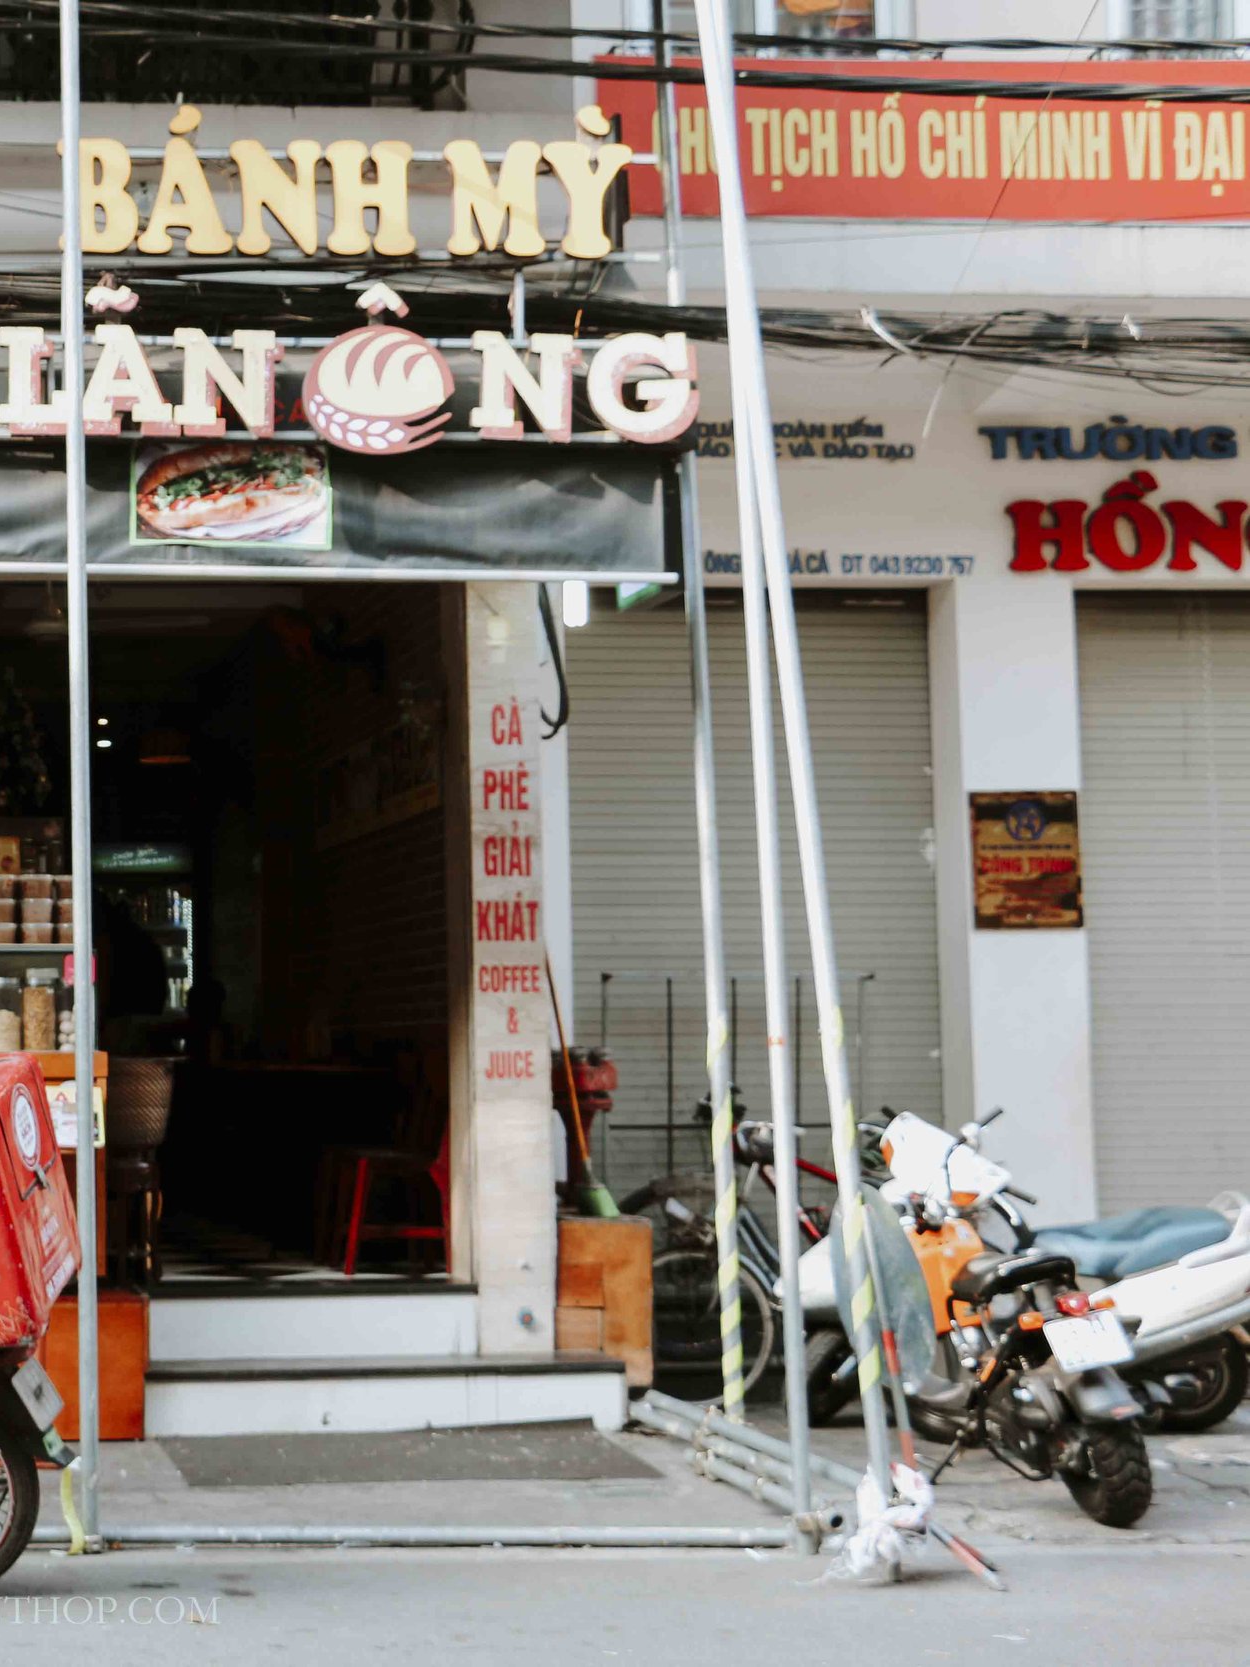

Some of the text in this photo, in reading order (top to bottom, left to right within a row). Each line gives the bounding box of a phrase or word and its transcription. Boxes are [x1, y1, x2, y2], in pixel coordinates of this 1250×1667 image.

[746, 107, 839, 192] TỊCH
[918, 95, 988, 180] CHÍ
[999, 110, 1112, 181] MINH
[1173, 110, 1245, 197] ĐẠI
[58, 104, 416, 256] BÁNH
[443, 104, 633, 259] MỲ
[1005, 470, 1250, 572] HỒN
[483, 762, 530, 810] PHÊ
[478, 965, 540, 992] COFFEE
[506, 1006, 519, 1034] &
[485, 1051, 535, 1080] JUICE
